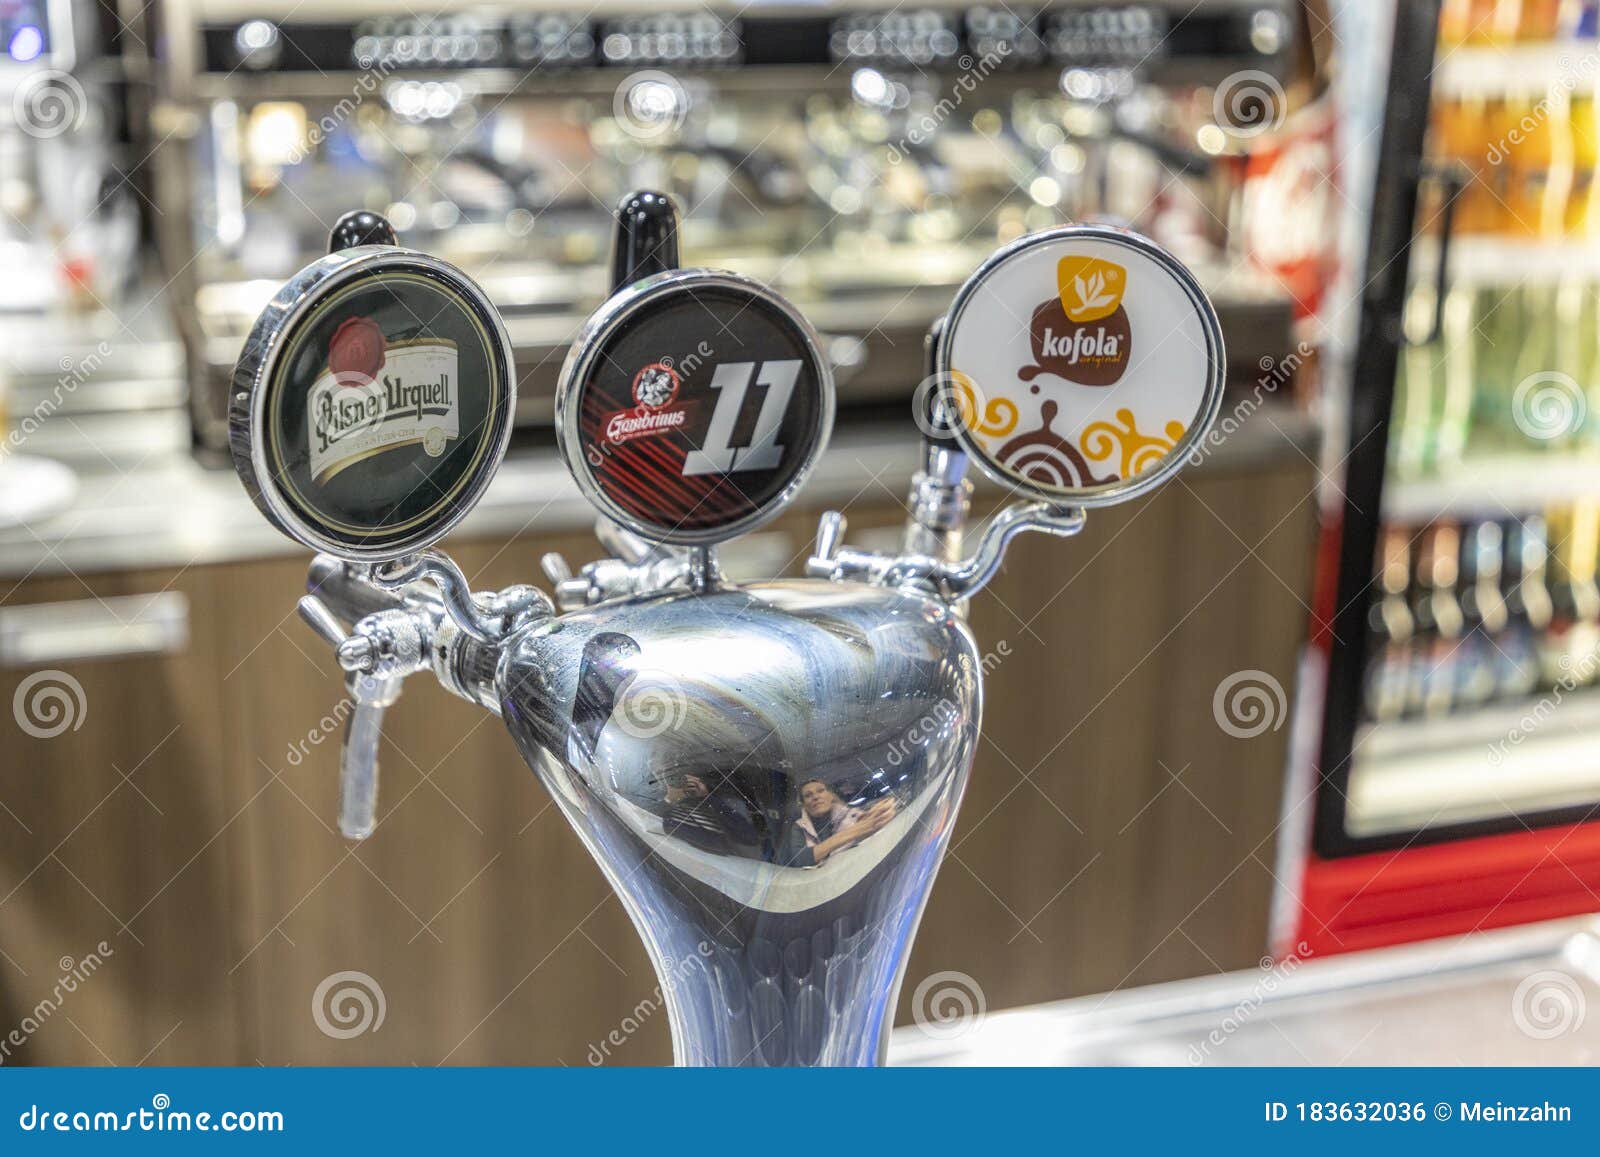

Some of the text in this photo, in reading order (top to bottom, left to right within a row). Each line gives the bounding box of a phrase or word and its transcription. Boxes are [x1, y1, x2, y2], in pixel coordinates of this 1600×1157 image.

[1041, 327, 1118, 365] kofola
[316, 389, 387, 454] Pilsner
[606, 410, 685, 438] Gambrinus
[682, 359, 803, 476] 11
